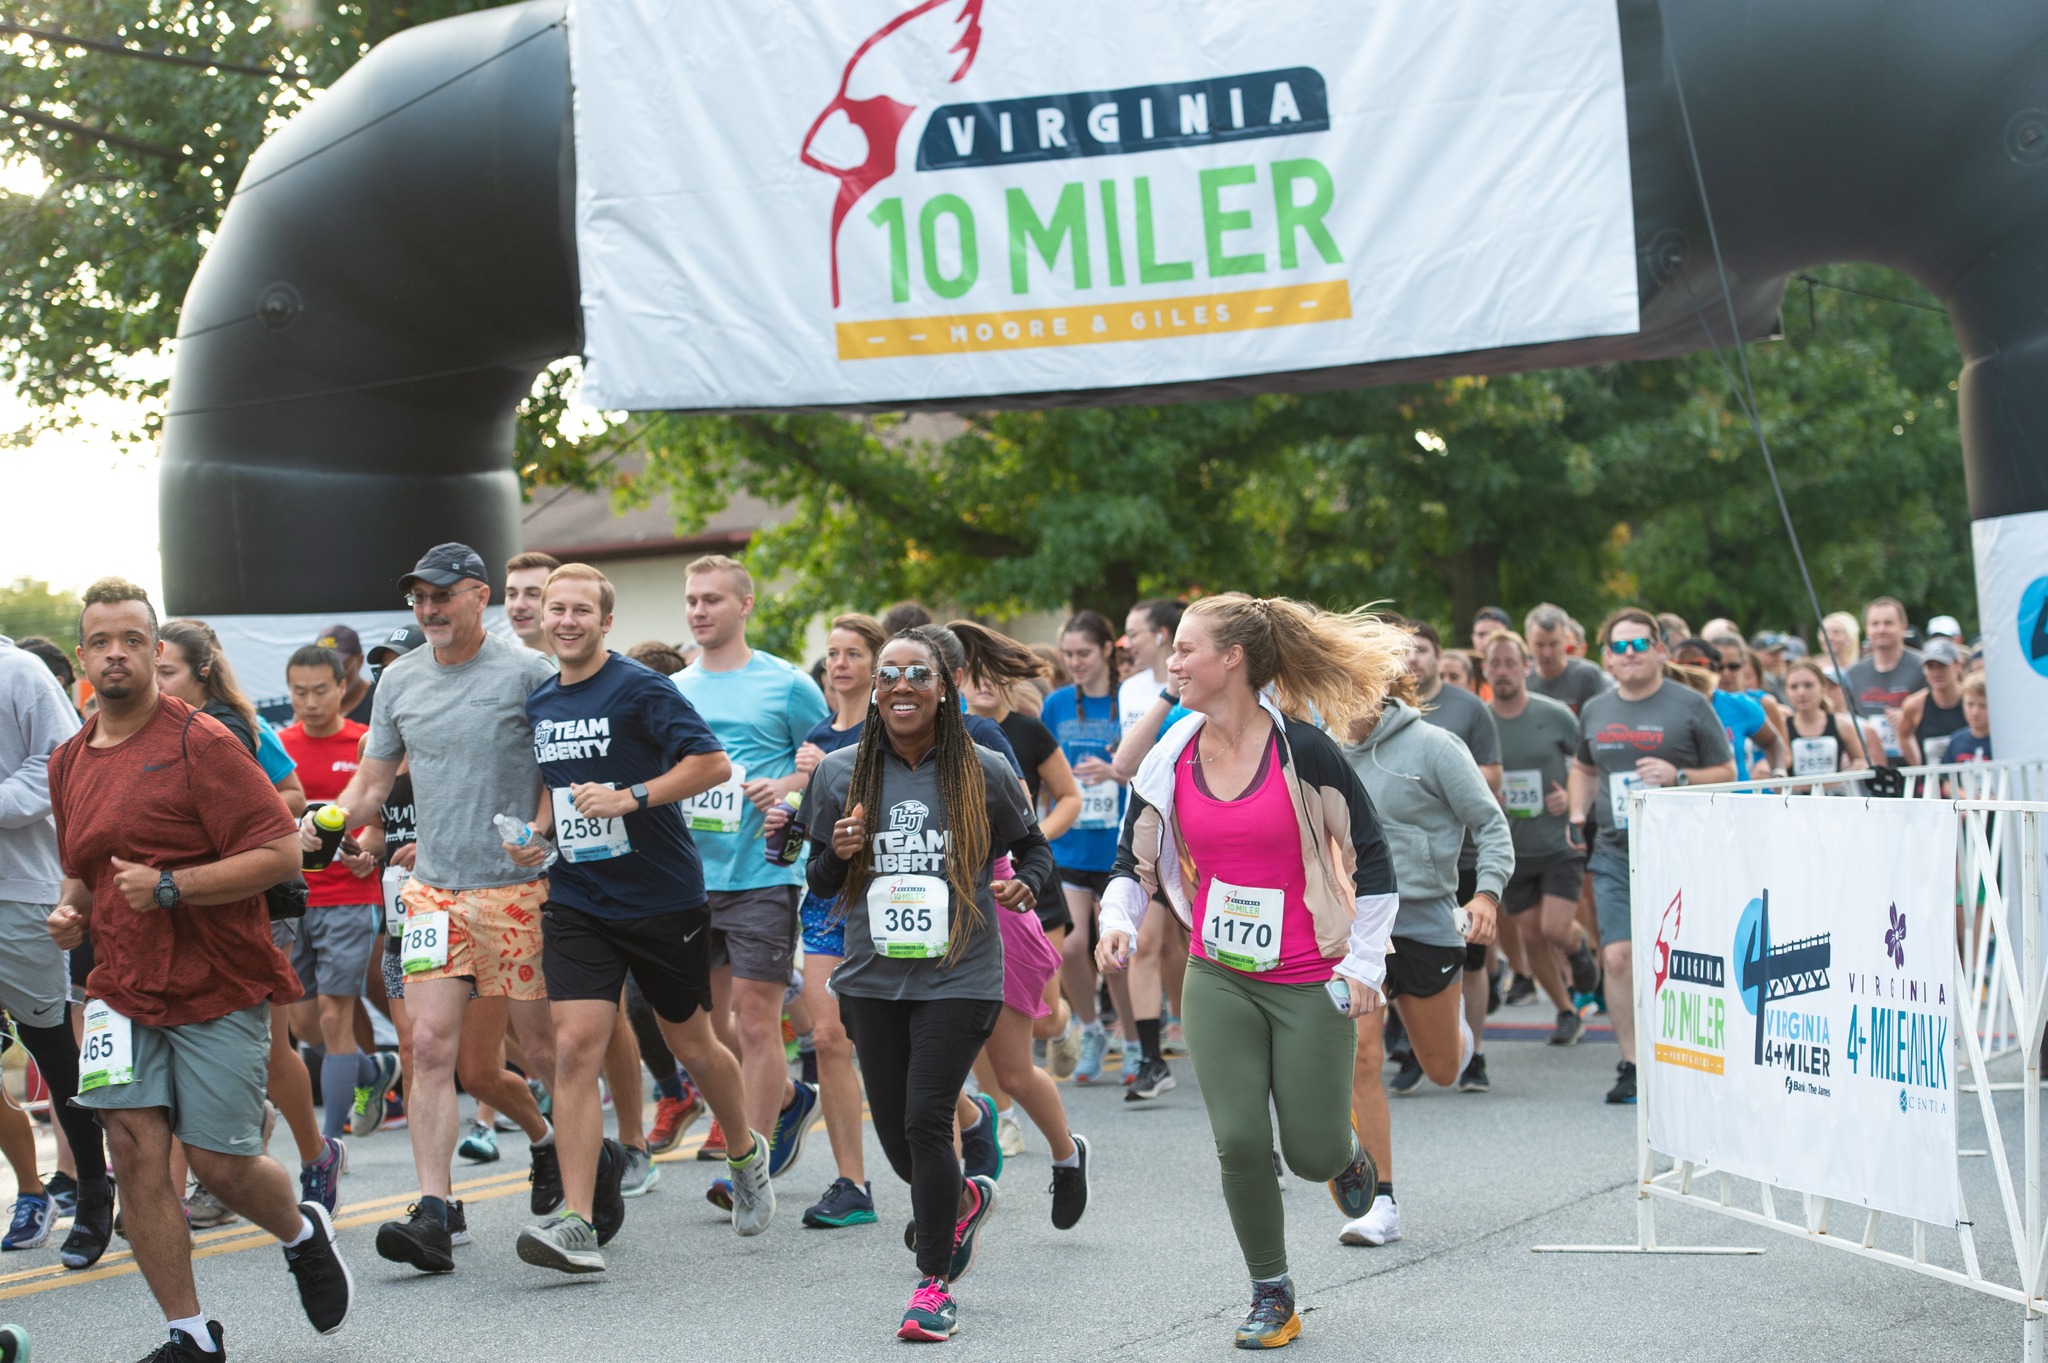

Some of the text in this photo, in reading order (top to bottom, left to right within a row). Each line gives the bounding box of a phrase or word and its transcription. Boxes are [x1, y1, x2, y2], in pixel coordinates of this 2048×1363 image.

[947, 82, 1301, 157] VIRGINIA
[867, 157, 1344, 303] 10 MILER
[950, 302, 1231, 343] MOORE & GILES
[553, 717, 610, 740] TEAM
[533, 738, 612, 764] LIBERTY
[867, 829, 953, 854] TEAM
[868, 853, 954, 873] IBERT
[502, 903, 535, 926] NIKE
[885, 908, 932, 932] 365
[1226, 903, 1235, 912] 10
[1235, 905, 1260, 915] MILER
[403, 928, 437, 953] 788
[1211, 915, 1272, 948] 1170
[1848, 972, 1946, 1005] VIRGINIA
[1661, 988, 1725, 1051] 10 MILER
[1766, 1008, 1831, 1045] VIRGINIA
